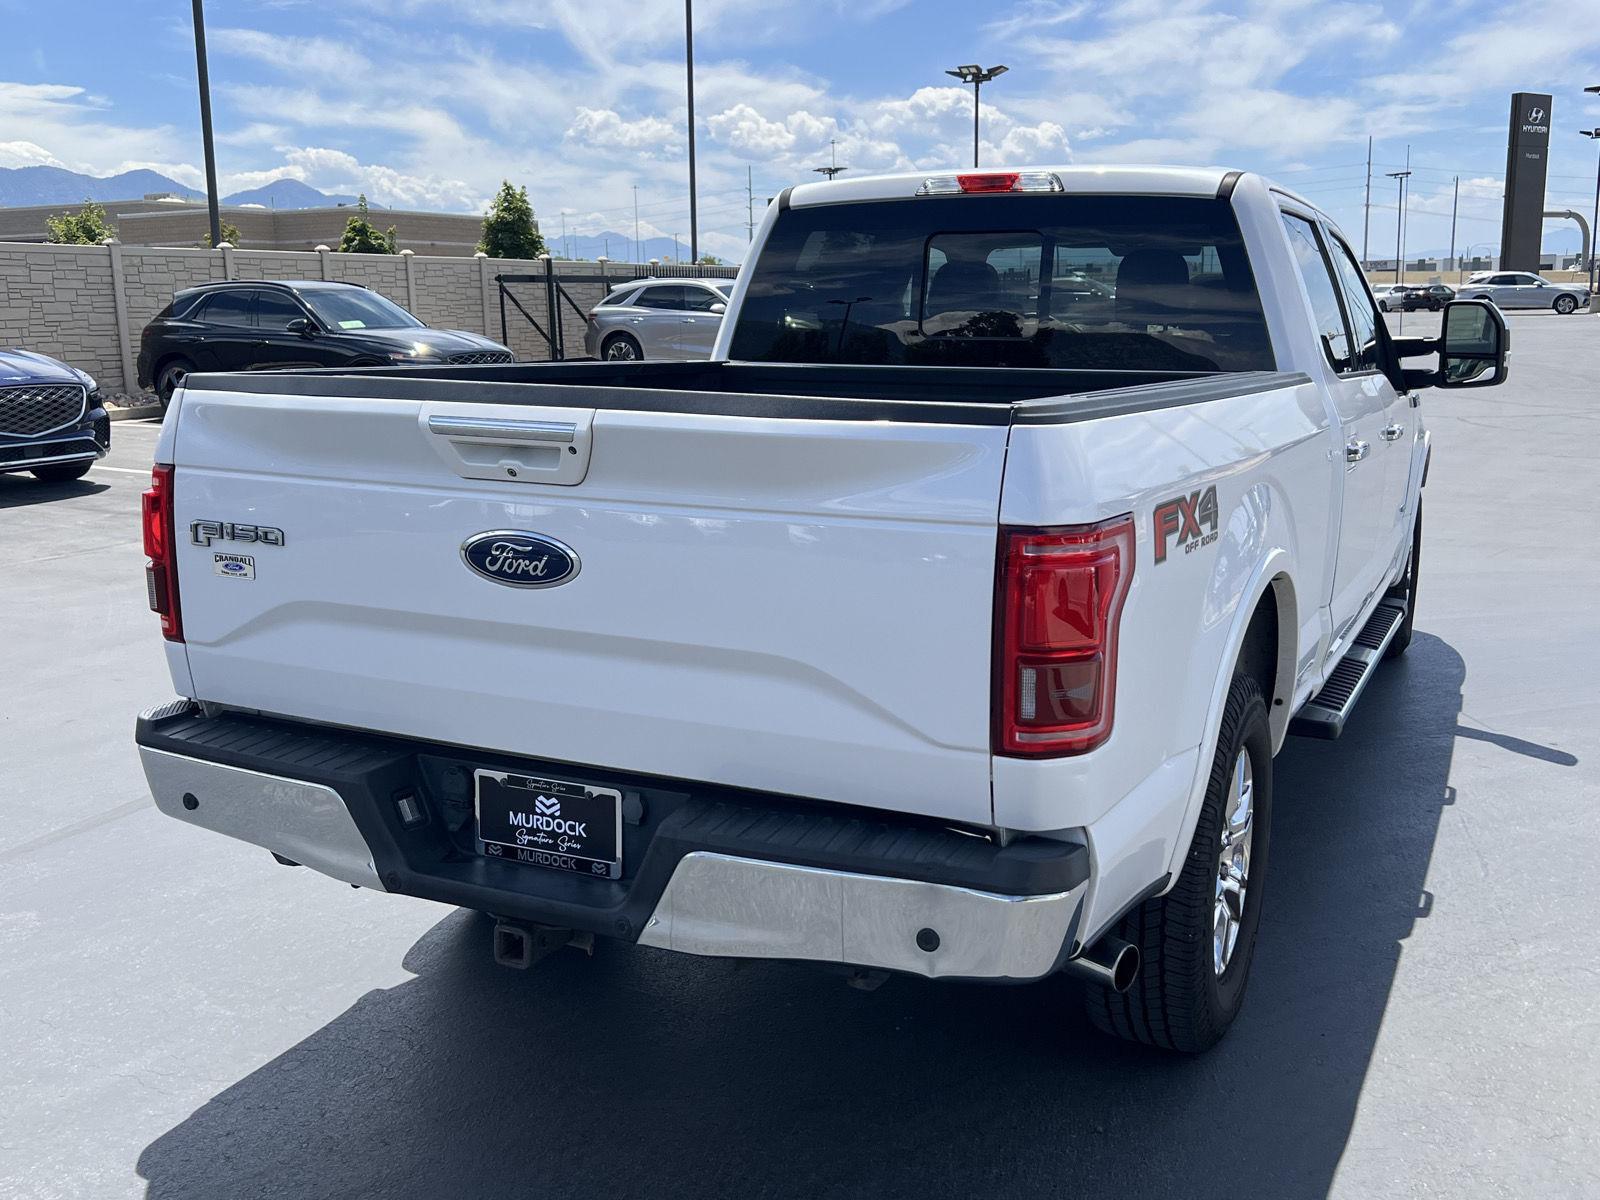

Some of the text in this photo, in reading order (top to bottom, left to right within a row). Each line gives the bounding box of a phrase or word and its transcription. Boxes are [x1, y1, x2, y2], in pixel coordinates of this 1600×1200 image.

[1522, 124, 1548, 134] HYUNDAI
[1153, 483, 1219, 567] FX4
[1184, 531, 1219, 555] OFF ROAD
[214, 553, 253, 567] CRANDALL
[485, 541, 549, 577] Ford
[509, 810, 587, 838] MURDOCK
[515, 828, 581, 852] Signature Series
[517, 848, 577, 870] MURDOCK
